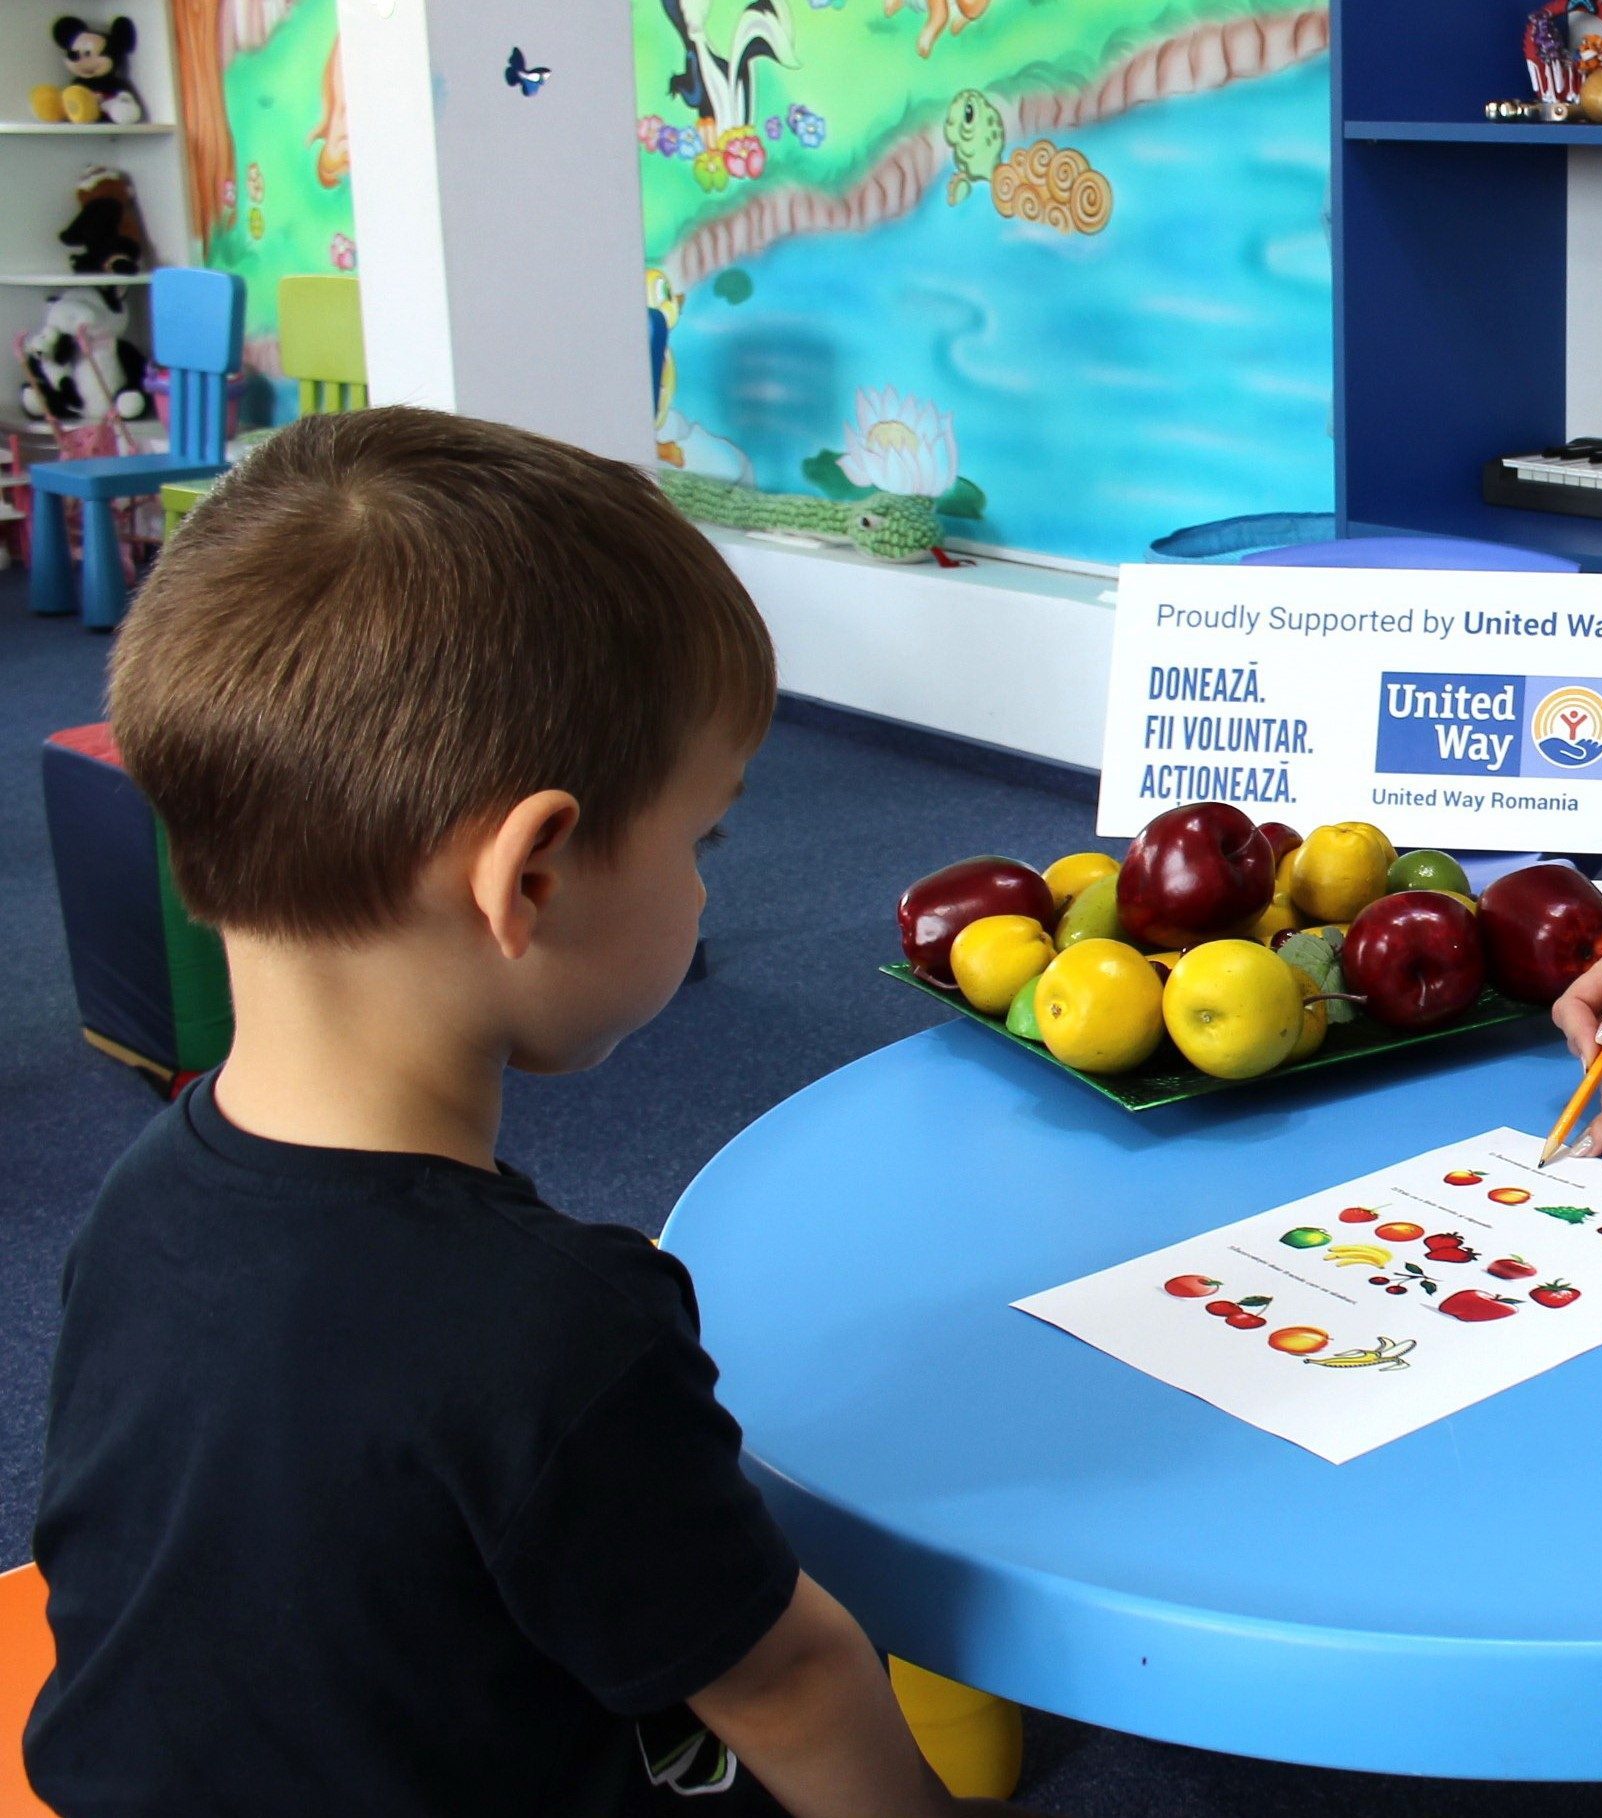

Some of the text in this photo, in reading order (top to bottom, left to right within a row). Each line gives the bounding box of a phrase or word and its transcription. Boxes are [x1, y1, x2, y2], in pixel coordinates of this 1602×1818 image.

[1156, 603, 1261, 636] Proudly
[1269, 606, 1414, 637] Supported
[1423, 609, 1455, 640] by
[1464, 610, 1558, 637] United
[1148, 660, 1266, 703] DONEAZĂ.
[1386, 683, 1516, 721] United
[1144, 715, 1314, 754] FII VOLUNTAR.
[1434, 724, 1514, 772] Way
[1371, 788, 1580, 813] United Way Romania
